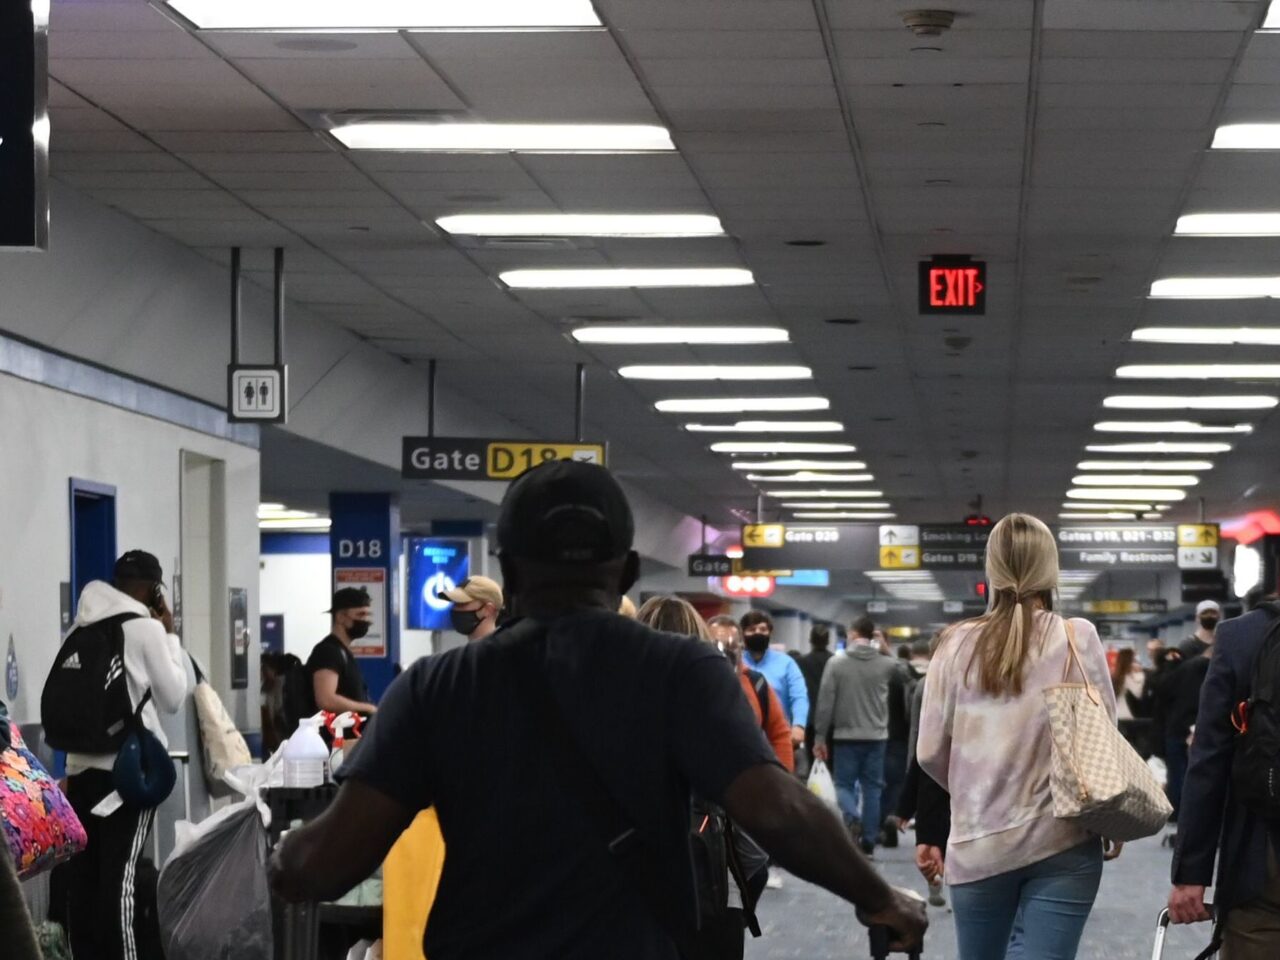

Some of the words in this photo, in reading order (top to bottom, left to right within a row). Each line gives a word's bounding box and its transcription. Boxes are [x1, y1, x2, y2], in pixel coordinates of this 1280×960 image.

[930, 269, 978, 306] EXIT
[410, 447, 480, 470] Gate
[785, 531, 813, 542] Gate
[922, 531, 971, 543] Smoking
[1059, 531, 1092, 541] Gates
[340, 540, 381, 558] D18
[922, 552, 954, 562] Gates
[1080, 552, 1117, 564] Family
[1120, 552, 1175, 562] Restroom
[692, 559, 729, 572] Gate
